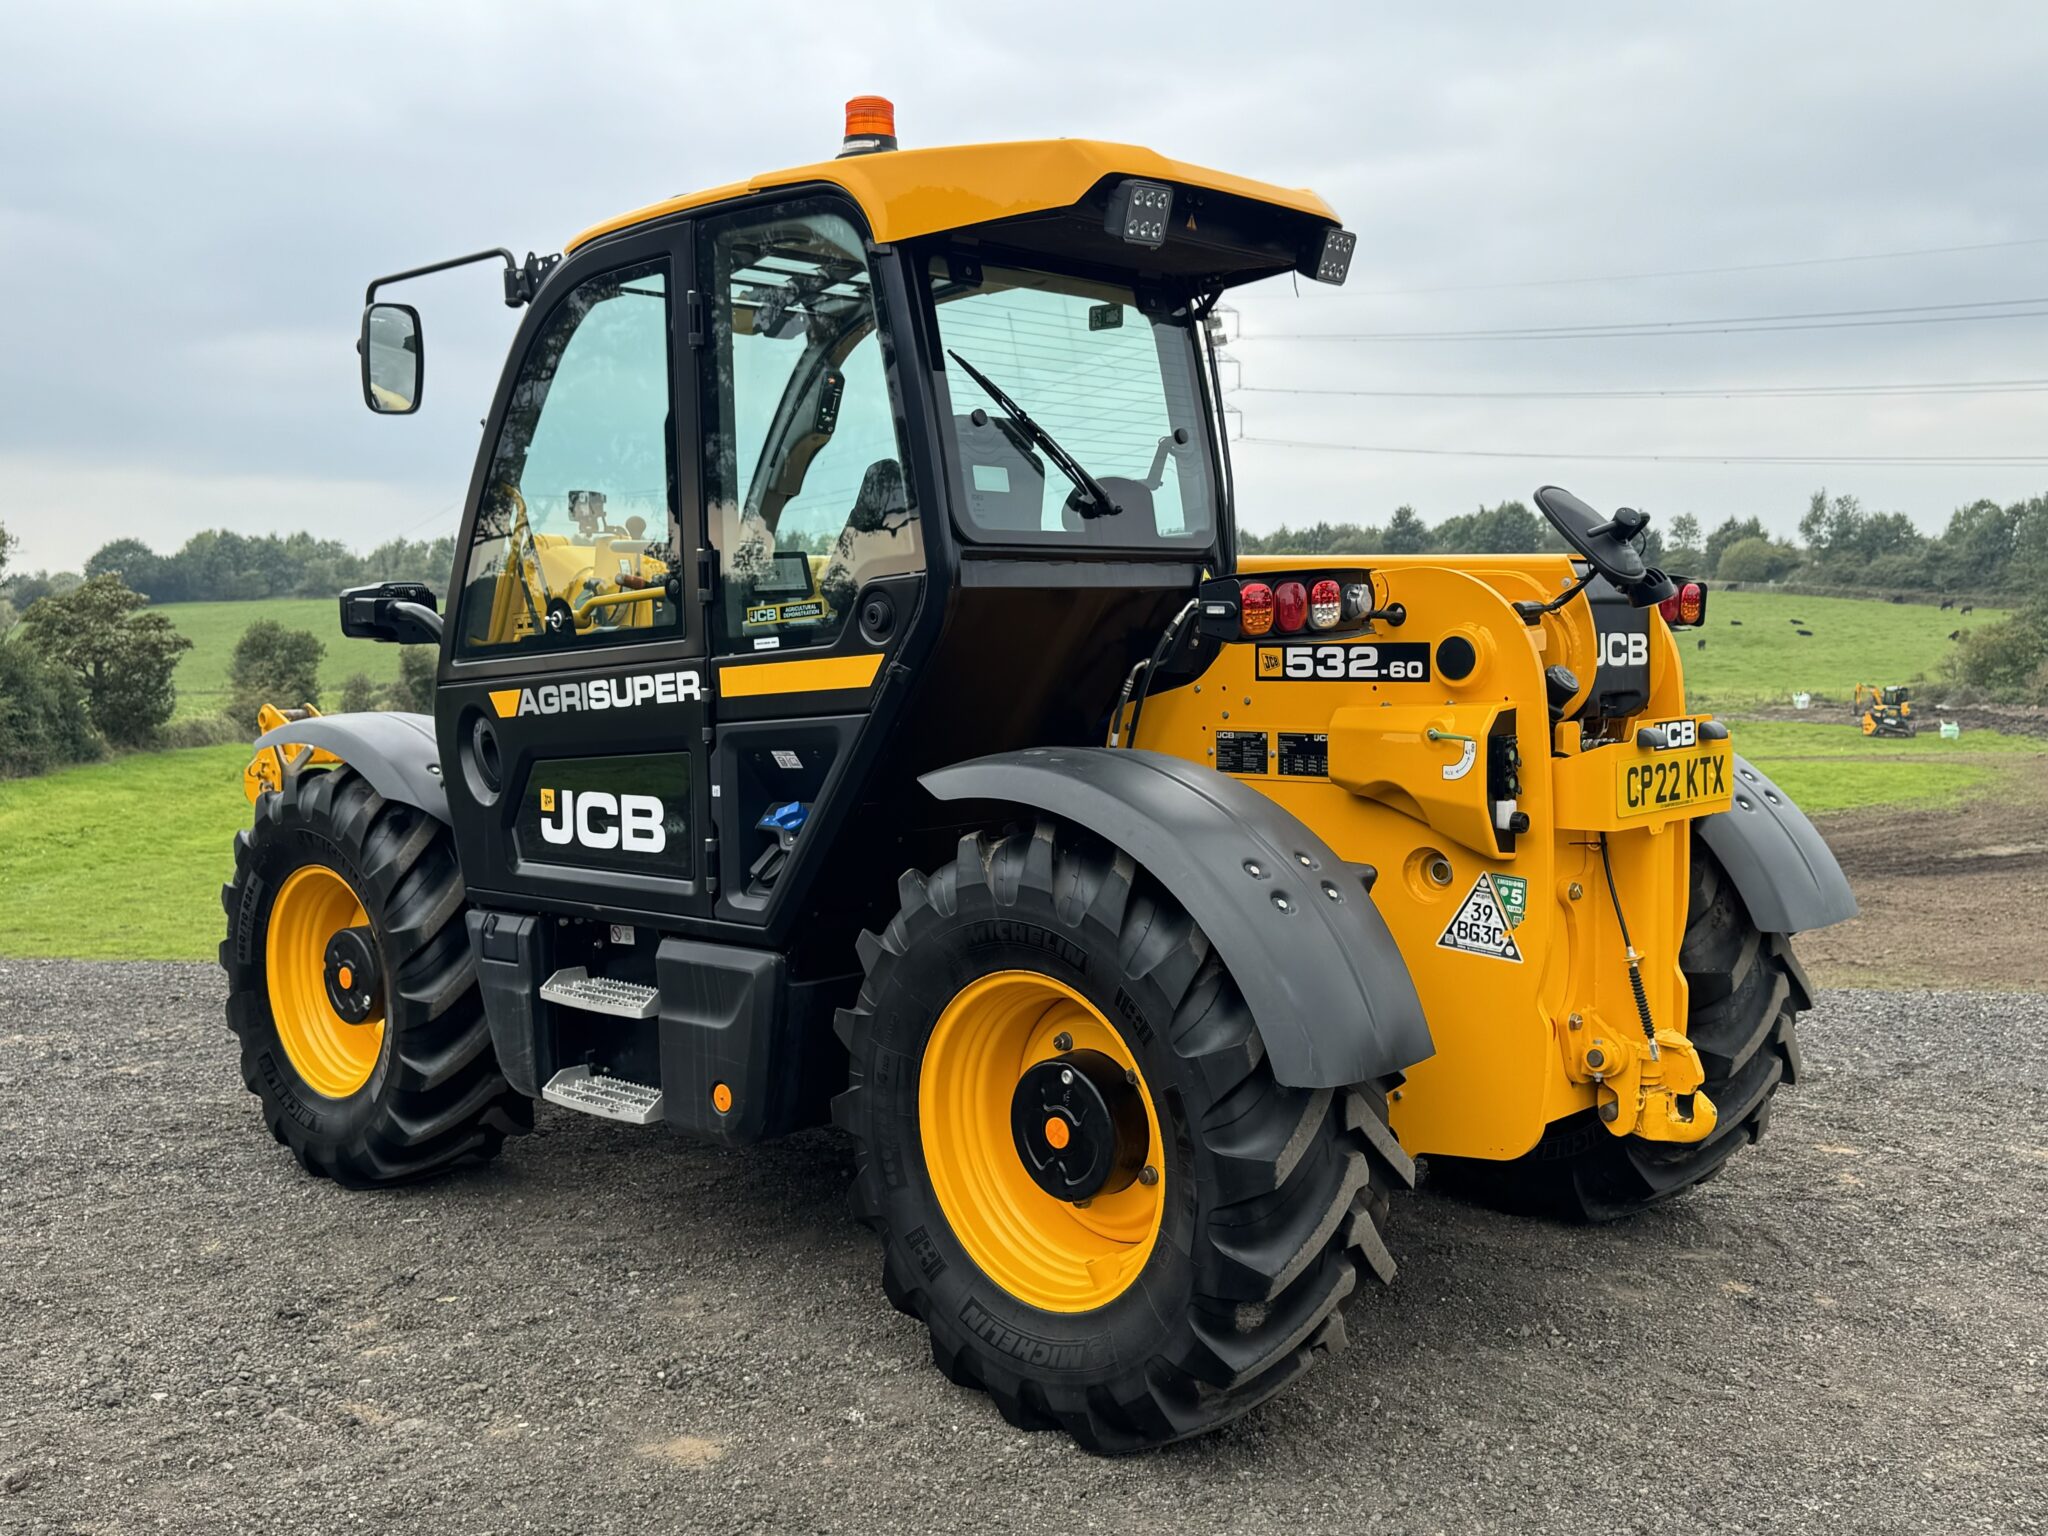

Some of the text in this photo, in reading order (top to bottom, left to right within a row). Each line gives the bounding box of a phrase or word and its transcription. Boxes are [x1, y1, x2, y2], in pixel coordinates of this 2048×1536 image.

[749, 608, 777, 622] JCB
[1285, 646, 1424, 678] 532-60
[1597, 632, 1648, 667] JCB
[518, 670, 701, 717] AGRISUPER
[1216, 731, 1235, 739] JCB
[1313, 734, 1328, 742] JC
[1626, 755, 1725, 808] CP22 KTX
[540, 789, 667, 854] JCB
[1470, 901, 1493, 923] 39
[1510, 888, 1523, 905] 5
[966, 920, 1087, 968] MICHELIN
[1456, 920, 1504, 947] BG3C
[960, 1304, 1084, 1369] MICHELIN
